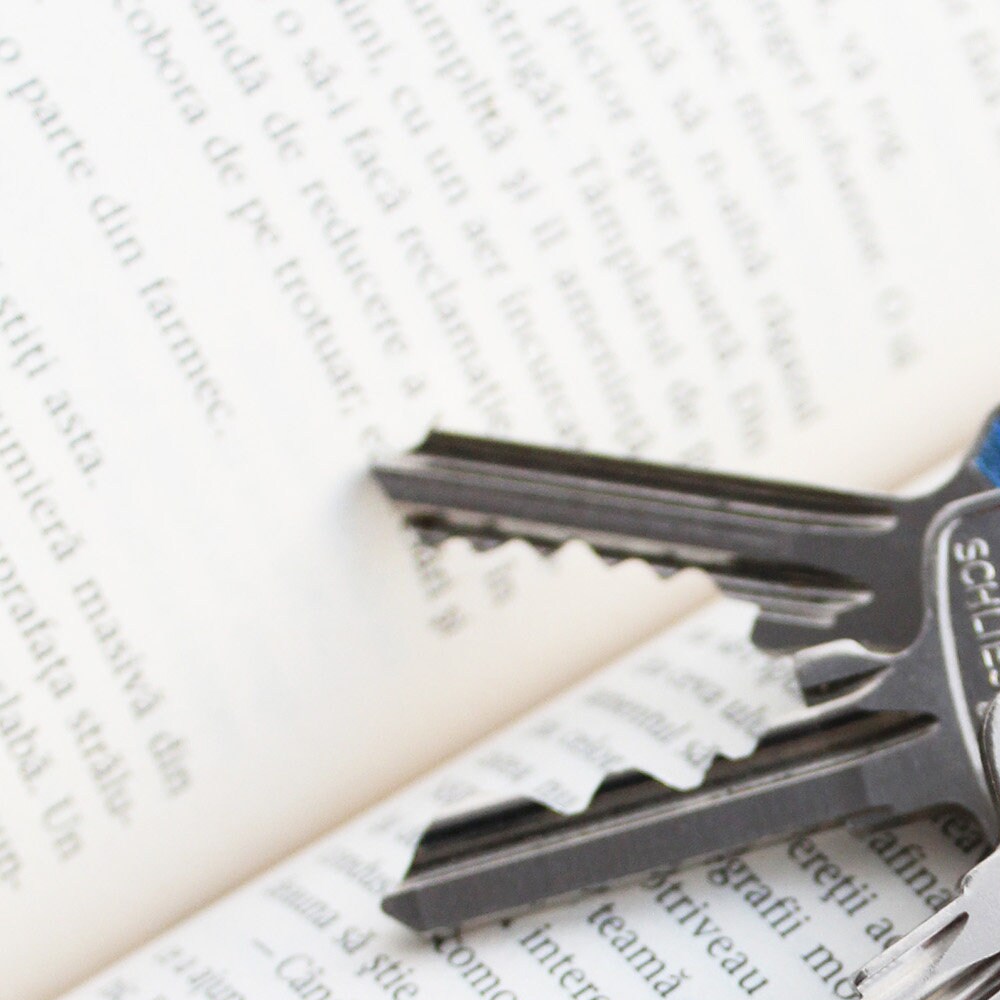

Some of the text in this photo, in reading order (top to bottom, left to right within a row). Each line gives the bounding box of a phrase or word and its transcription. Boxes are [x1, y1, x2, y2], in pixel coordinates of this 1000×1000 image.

[201, 135, 246, 183] de
[225, 196, 281, 246] pe
[261, 111, 304, 161] de
[298, 179, 409, 355] reducere
[13, 76, 96, 180] parte
[87, 193, 145, 269] din
[136, 275, 235, 438] farmec.
[42, 391, 104, 487] asta.
[70, 576, 192, 798] masivă din
[41, 795, 83, 862] Un
[585, 902, 689, 999] teamă
